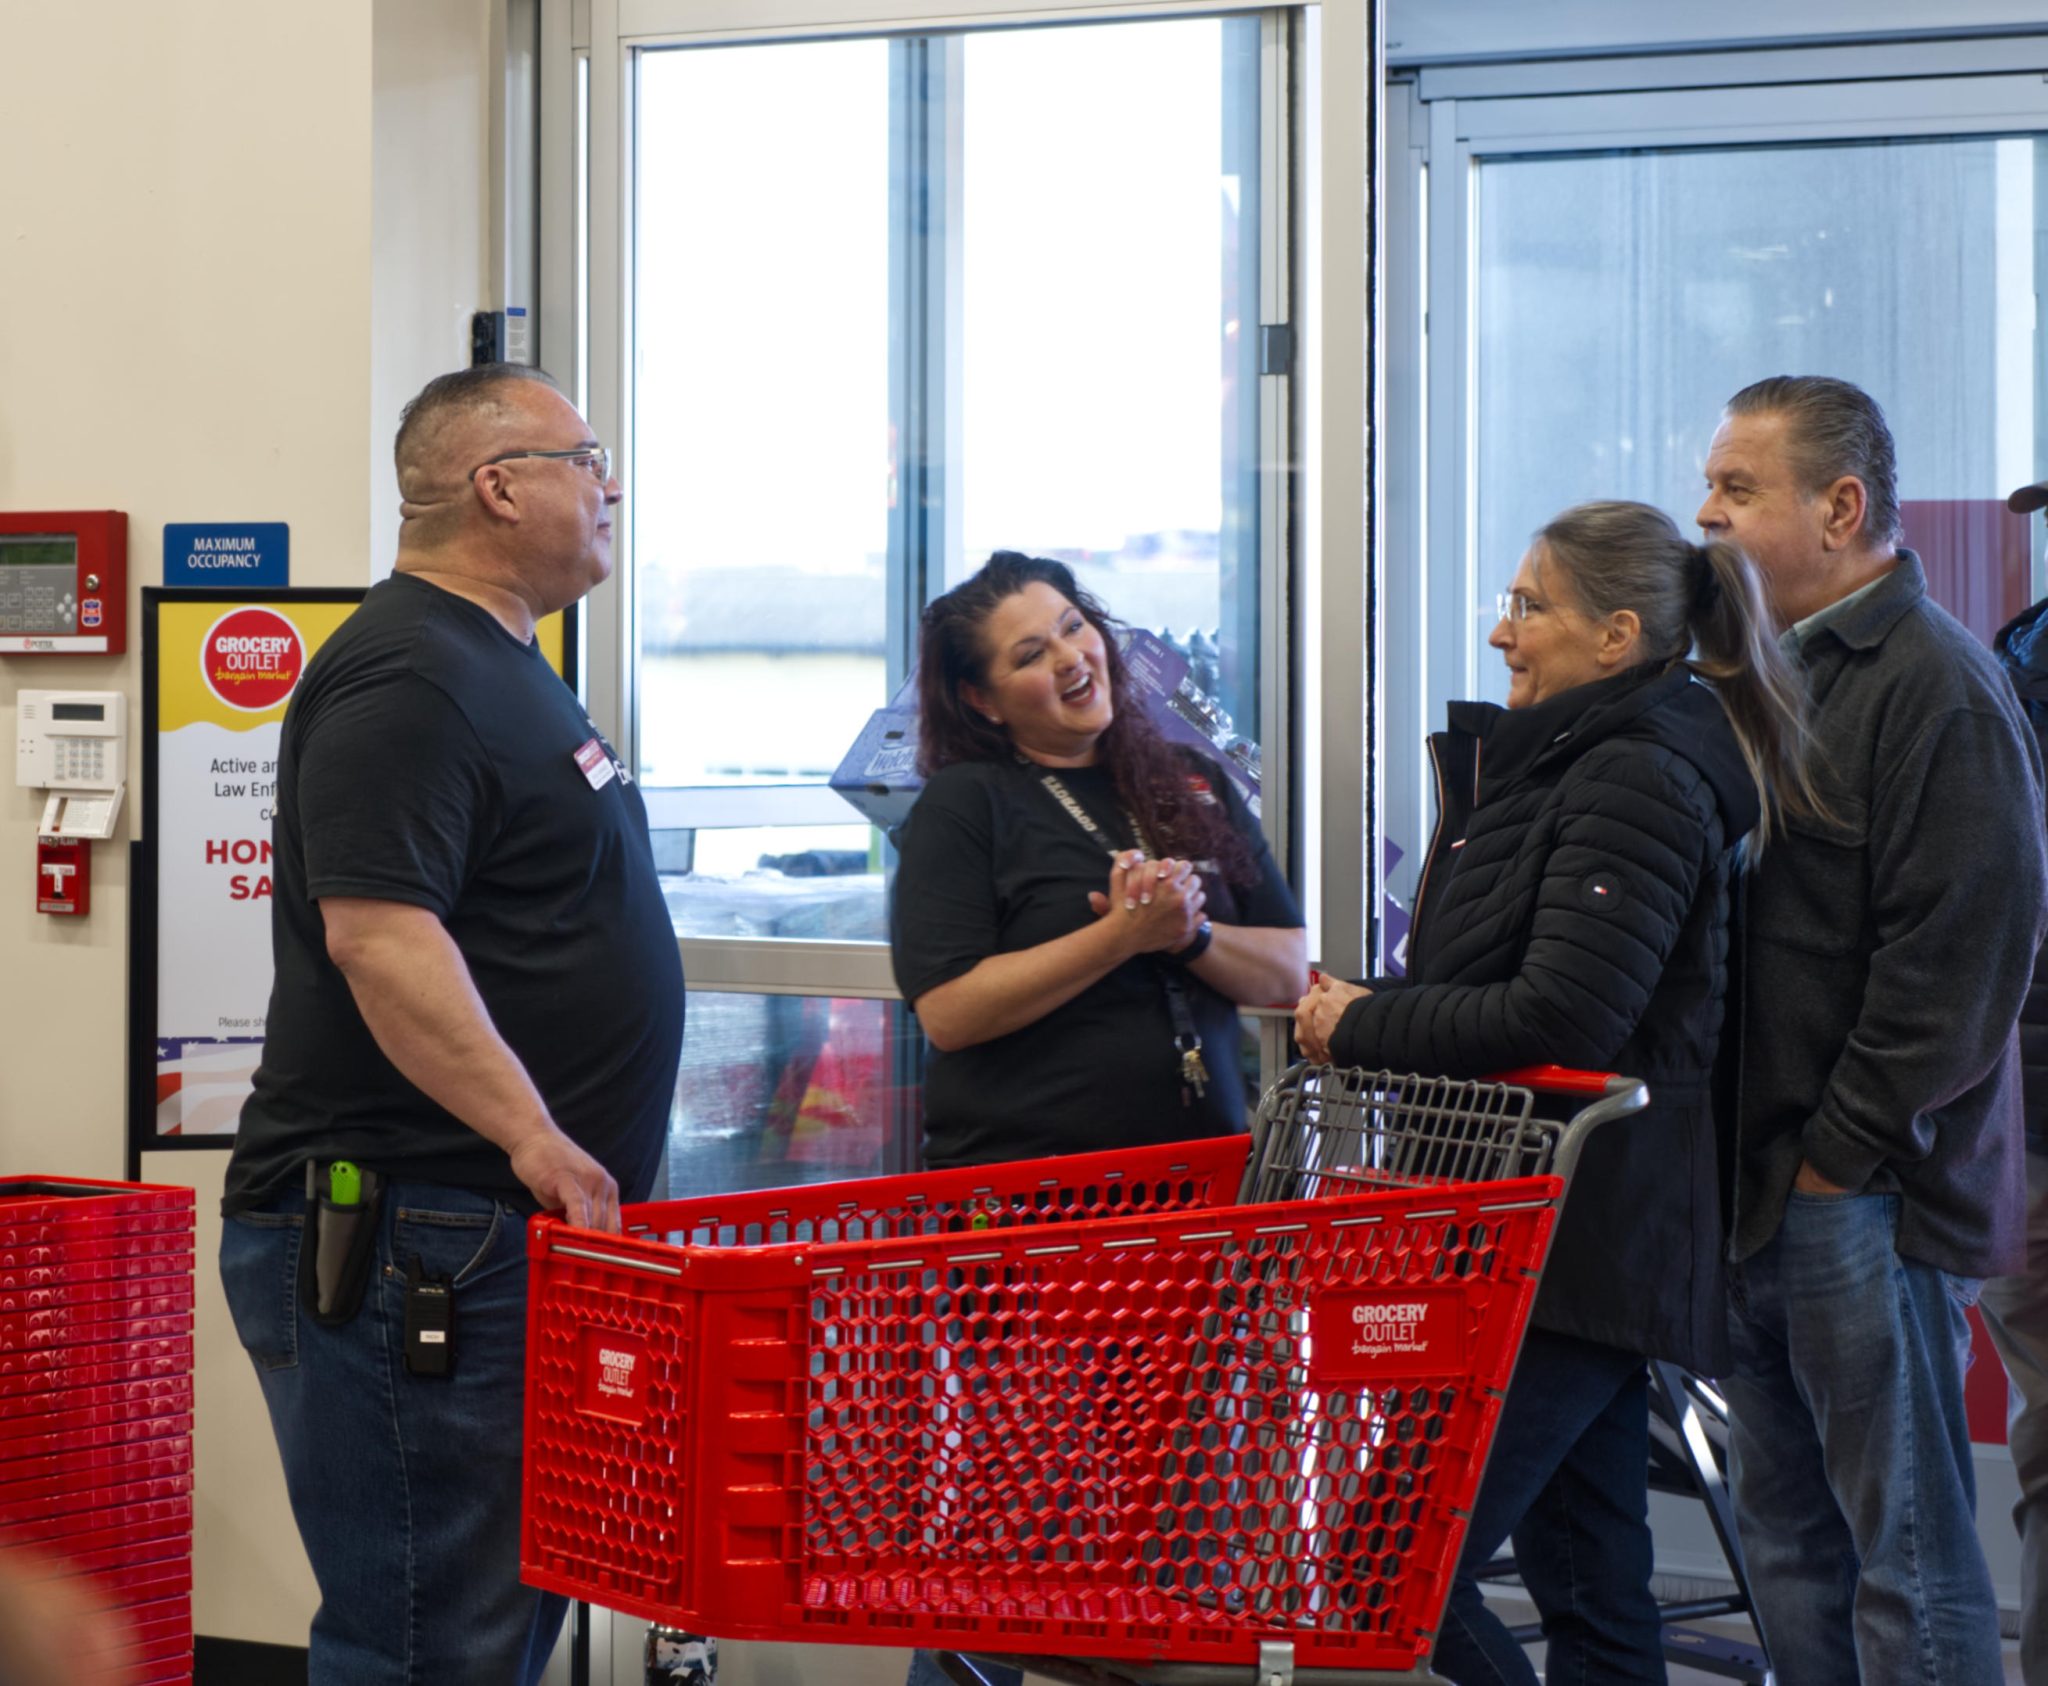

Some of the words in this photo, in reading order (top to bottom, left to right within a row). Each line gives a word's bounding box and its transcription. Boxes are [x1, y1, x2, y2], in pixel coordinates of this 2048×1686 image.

[194, 538, 255, 551] MAXIMUM
[188, 554, 261, 568] OCCUPANCY
[215, 636, 292, 653] GROCERY
[226, 653, 281, 671] OUTLET
[215, 666, 256, 685] bargain
[210, 758, 257, 774] Active
[214, 782, 246, 797] Law
[230, 875, 273, 900] SA
[218, 1017, 250, 1028] Please
[1352, 1303, 1428, 1324] GROCERY
[1363, 1322, 1418, 1342] OUTLET
[1352, 1339, 1392, 1359] bargain
[599, 1348, 636, 1371] GROCERY
[603, 1366, 630, 1386] OUTLET
